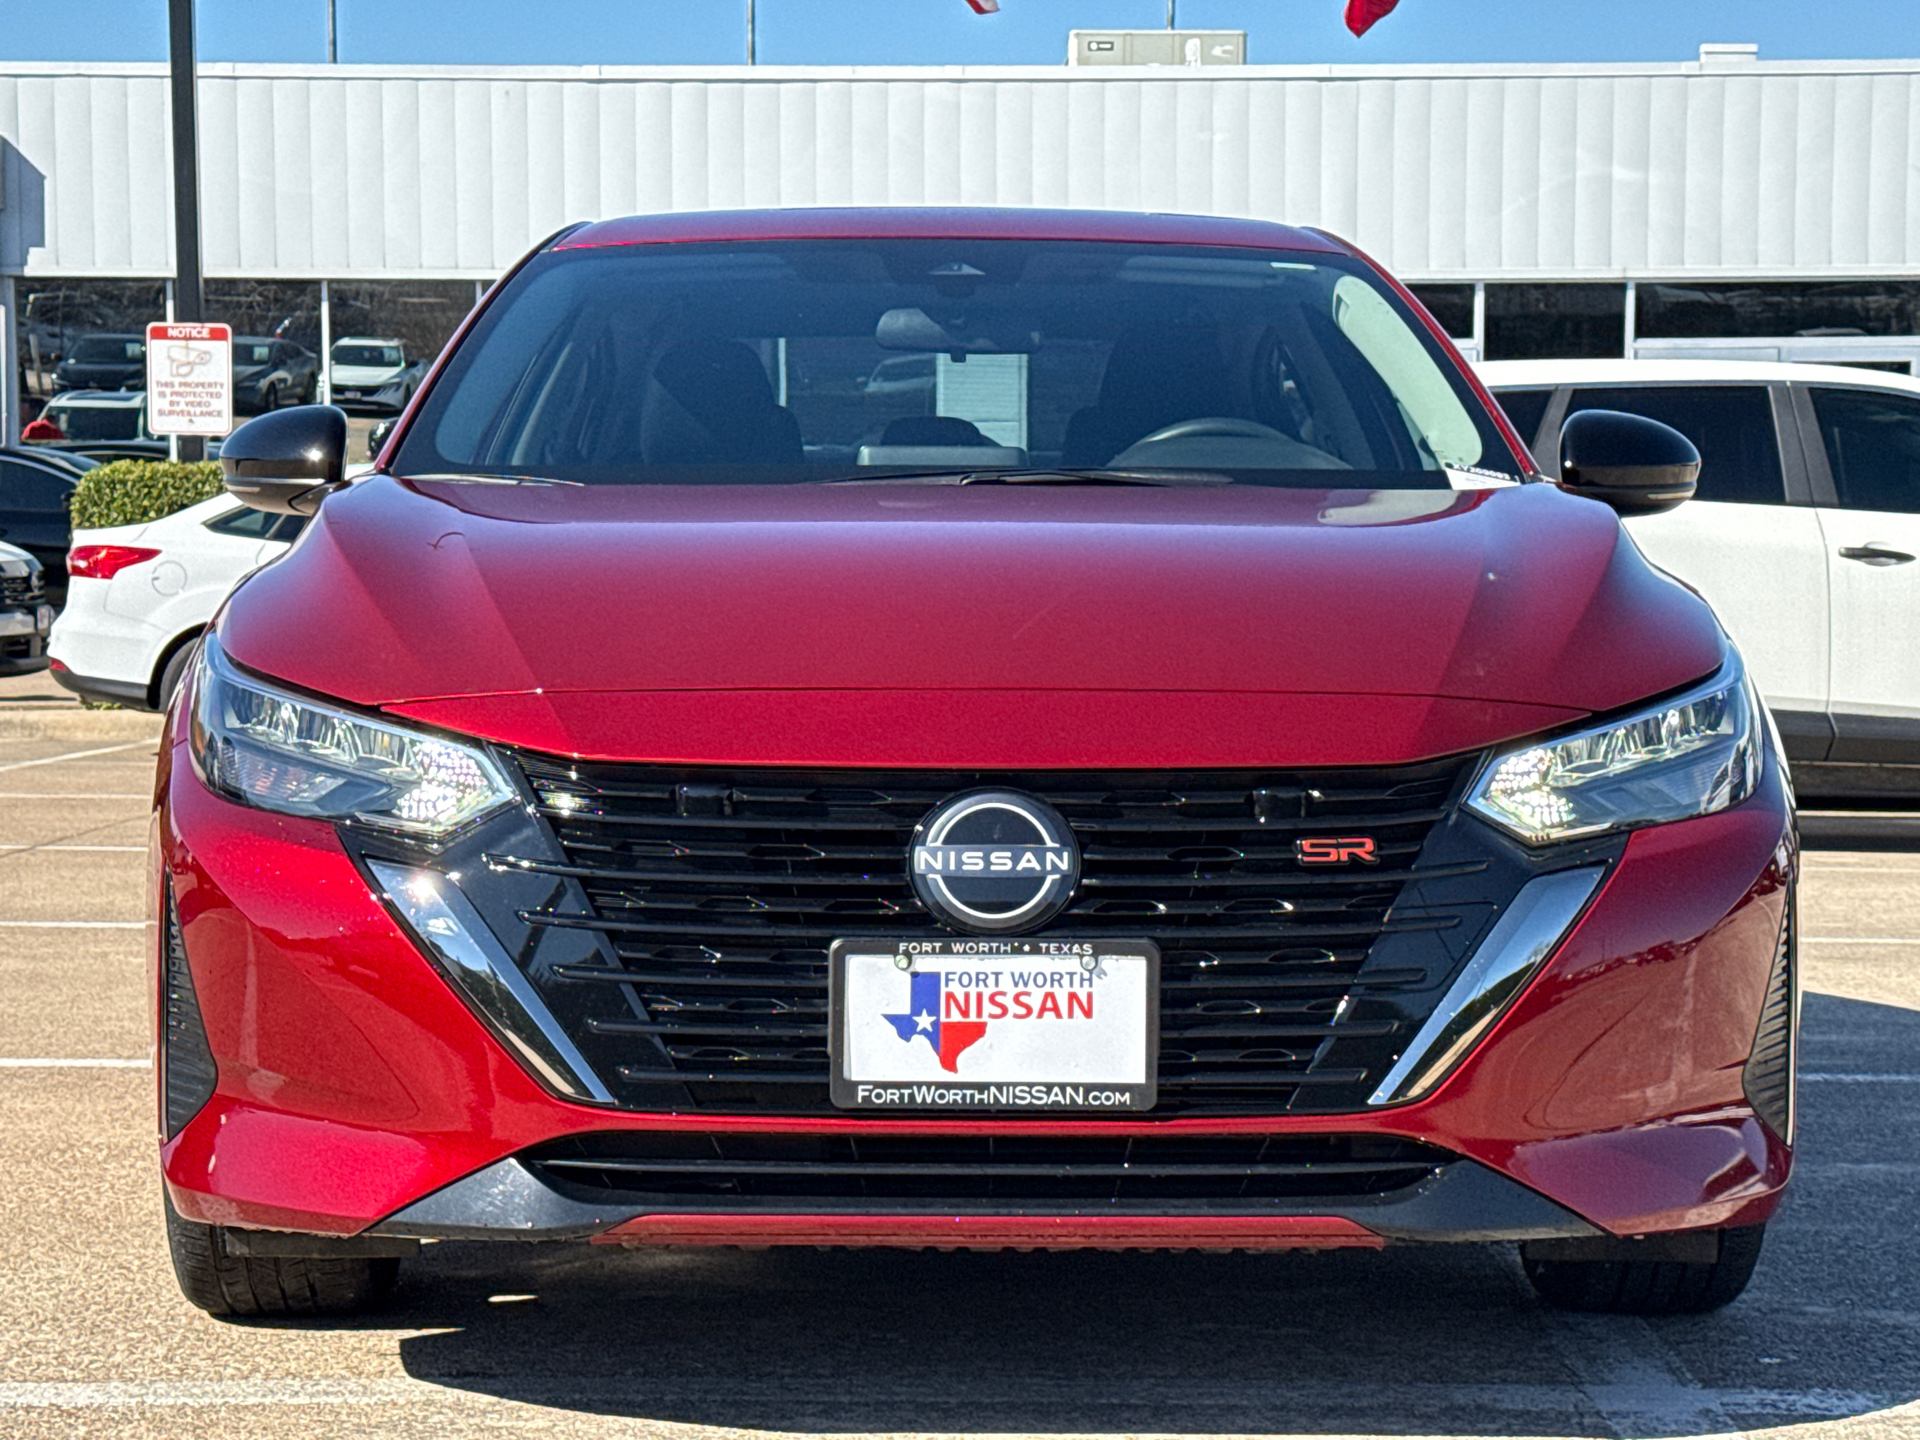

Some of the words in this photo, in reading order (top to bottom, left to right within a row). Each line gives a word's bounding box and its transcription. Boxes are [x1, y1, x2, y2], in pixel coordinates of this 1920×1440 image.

[167, 327, 211, 338] NOTICE
[156, 381, 175, 389] THIS
[178, 381, 225, 389] PROPERTY
[157, 391, 167, 399] IS
[170, 391, 222, 399] PROTECTED
[169, 400, 181, 408] BY
[184, 400, 211, 408] VIDEO
[157, 409, 223, 418] SURVEILLANCE
[1301, 837, 1376, 861] SR
[919, 851, 1069, 871] NISSAN
[899, 942, 942, 954] FORT
[951, 942, 1012, 954] WORTH
[1039, 943, 1093, 955] TEXAS
[944, 971, 1004, 988] FORT
[1010, 971, 1094, 989] WORTH
[944, 991, 1094, 1020] NISSAN
